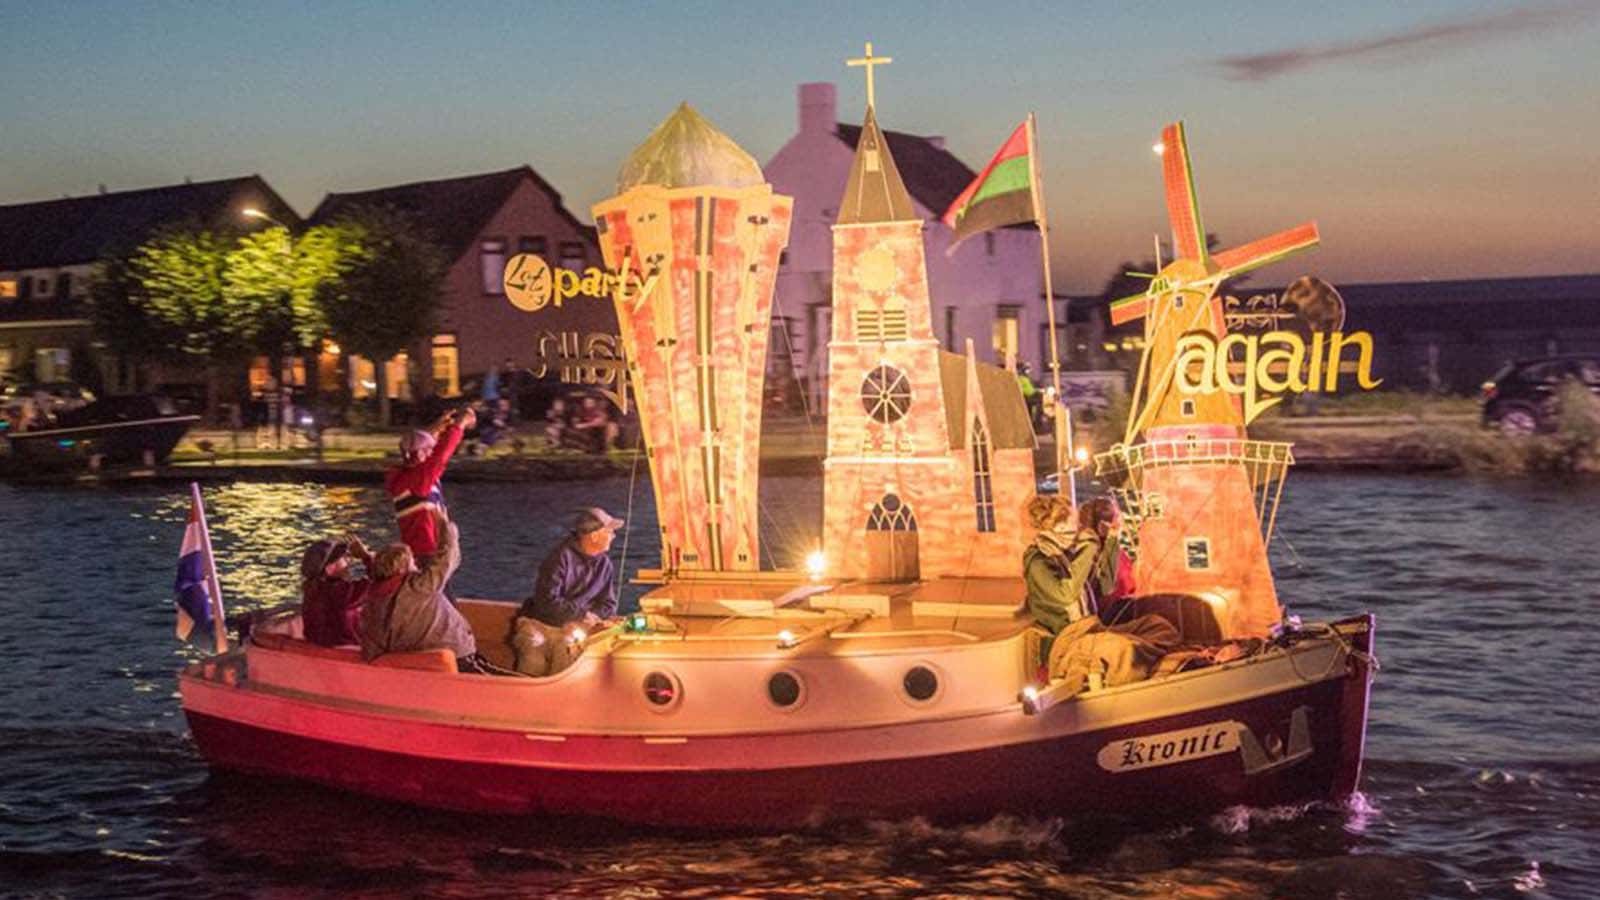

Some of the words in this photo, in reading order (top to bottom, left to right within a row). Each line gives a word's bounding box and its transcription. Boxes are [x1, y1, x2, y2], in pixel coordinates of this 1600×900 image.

[553, 256, 661, 315] party
[1175, 330, 1384, 425] again
[1119, 728, 1228, 767] Kronic
